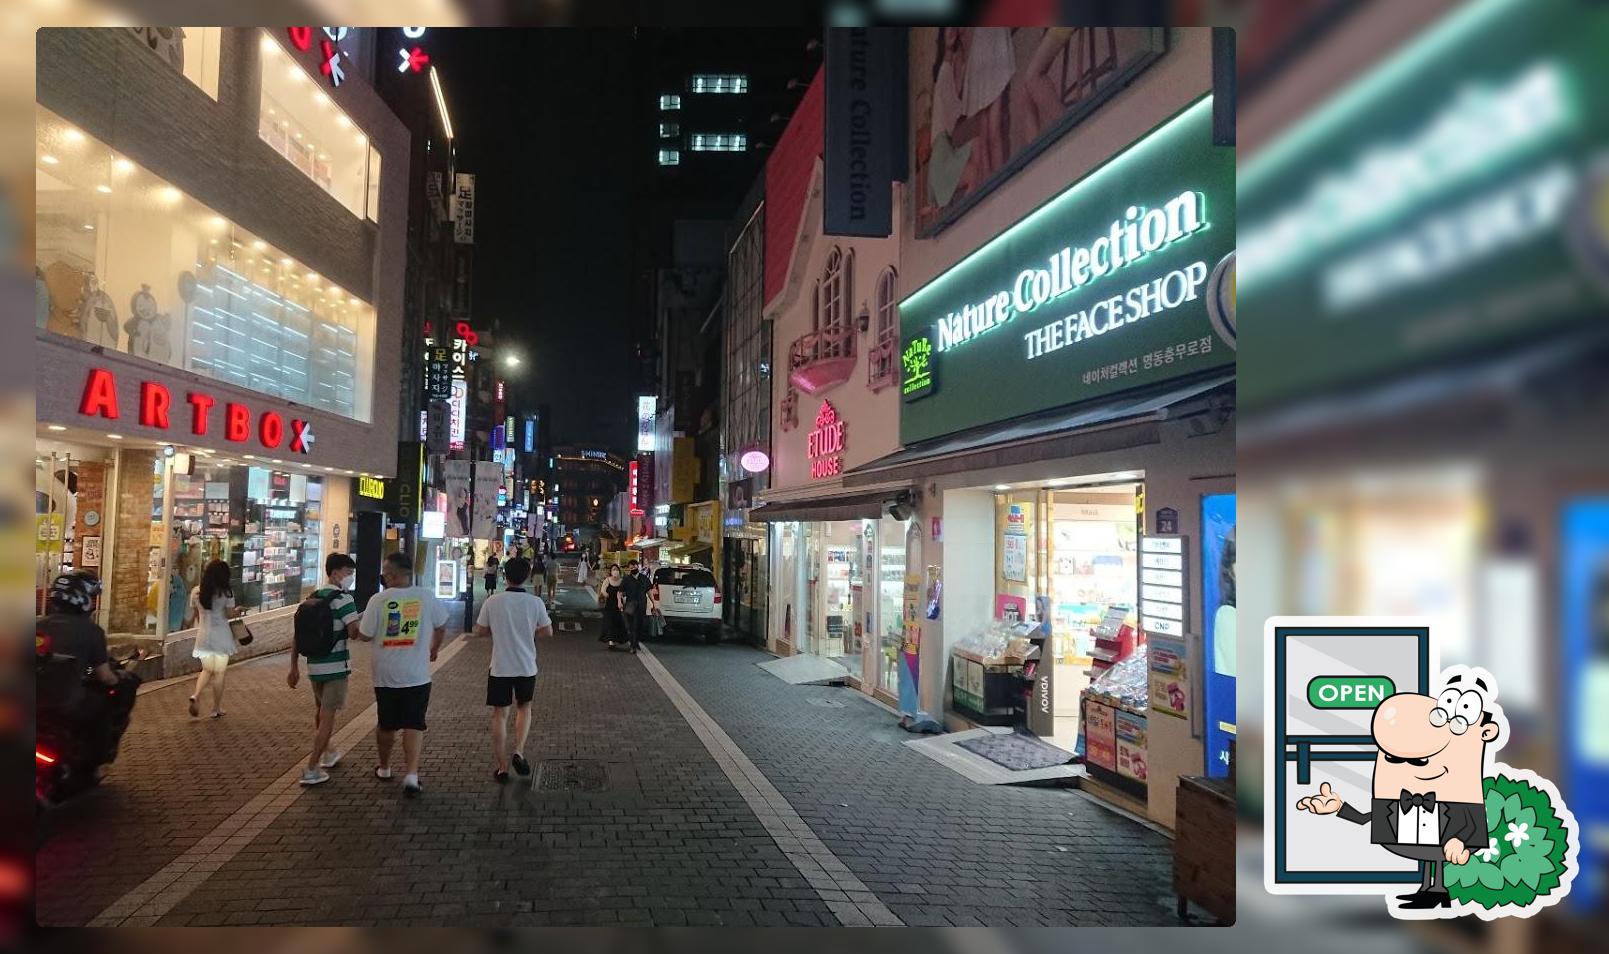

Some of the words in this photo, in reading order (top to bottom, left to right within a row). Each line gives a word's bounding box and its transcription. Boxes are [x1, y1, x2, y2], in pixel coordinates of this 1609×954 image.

[851, 100, 872, 221] Collection
[937, 290, 1010, 351] Nature
[1013, 190, 1205, 313] Collection
[1082, 357, 1138, 385] 네이처컬렉션
[1142, 335, 1212, 370] 명동충무로점
[78, 368, 315, 455] ARTBOX
[807, 420, 845, 460] ETUDE
[811, 456, 841, 481] HOUSE
[1040, 675, 1049, 714] VDIVOV
